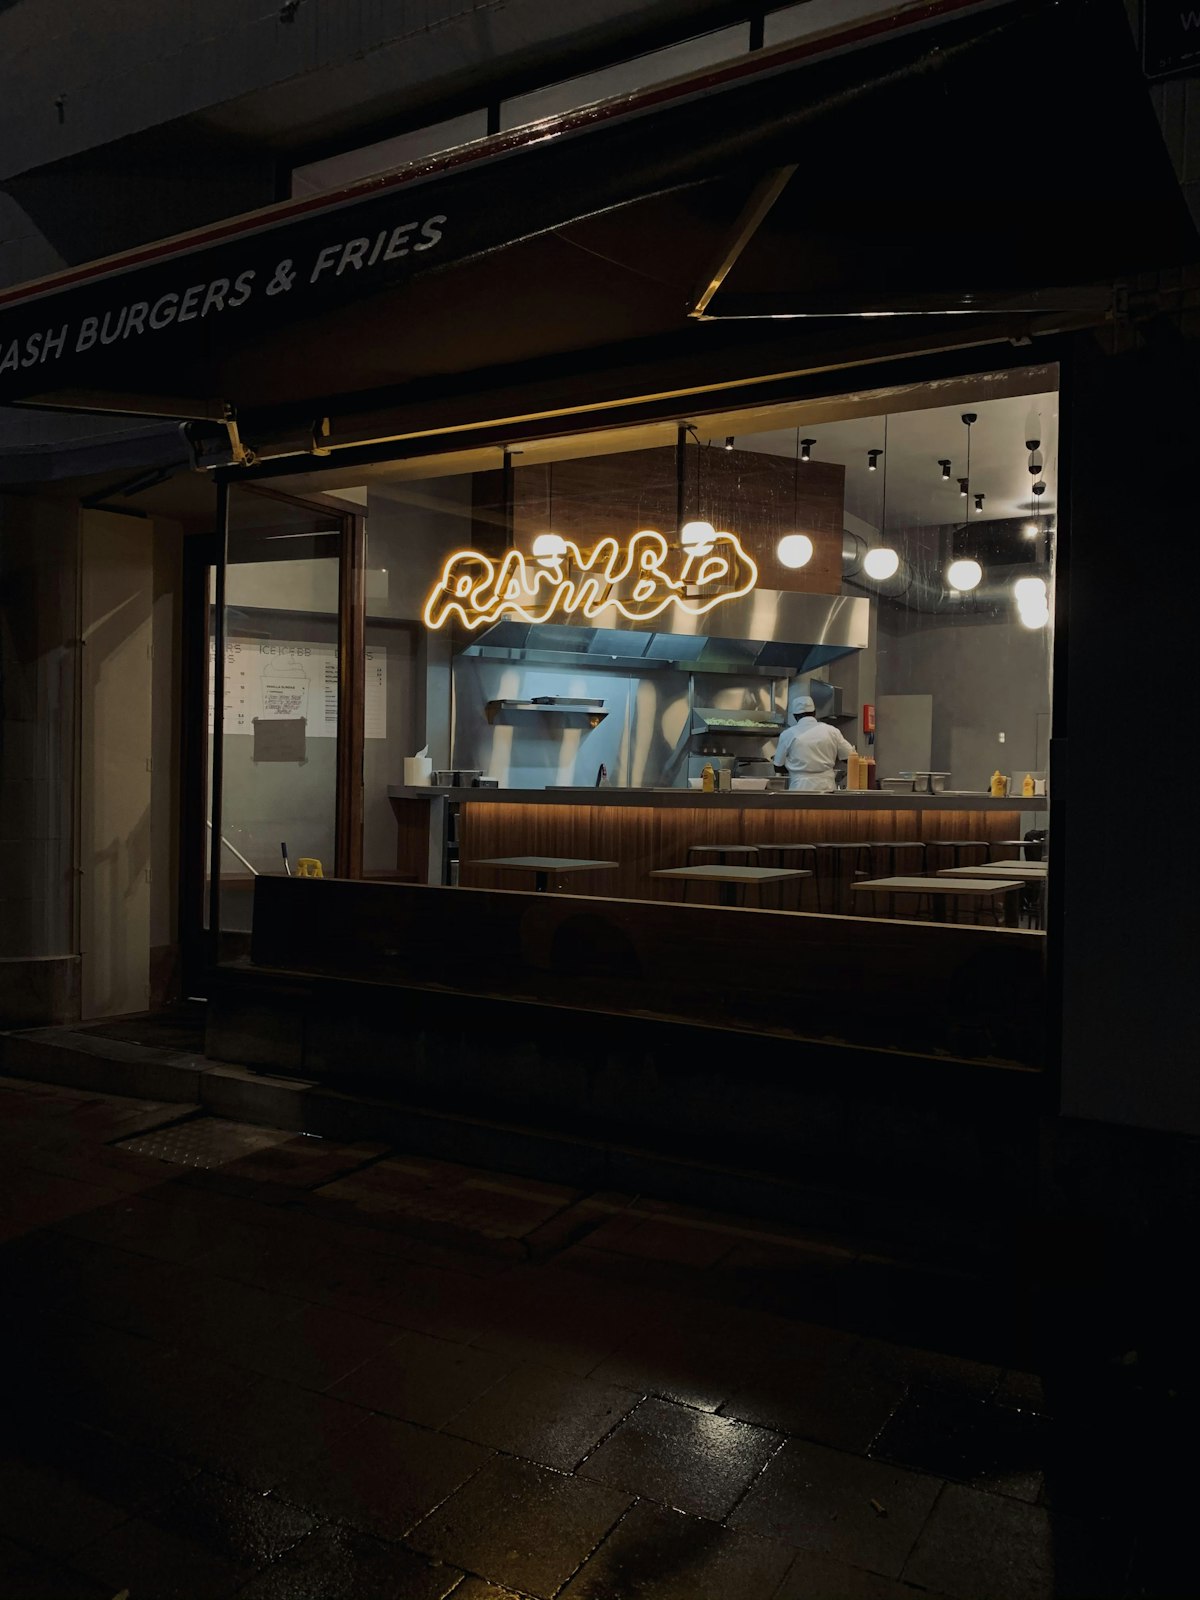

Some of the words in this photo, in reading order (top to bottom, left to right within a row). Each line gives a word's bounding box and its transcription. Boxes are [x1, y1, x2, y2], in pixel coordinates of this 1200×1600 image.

[0, 324, 69, 375] ASH
[75, 269, 256, 353] BURGERS
[265, 258, 297, 296] &
[309, 214, 448, 285] FRIES
